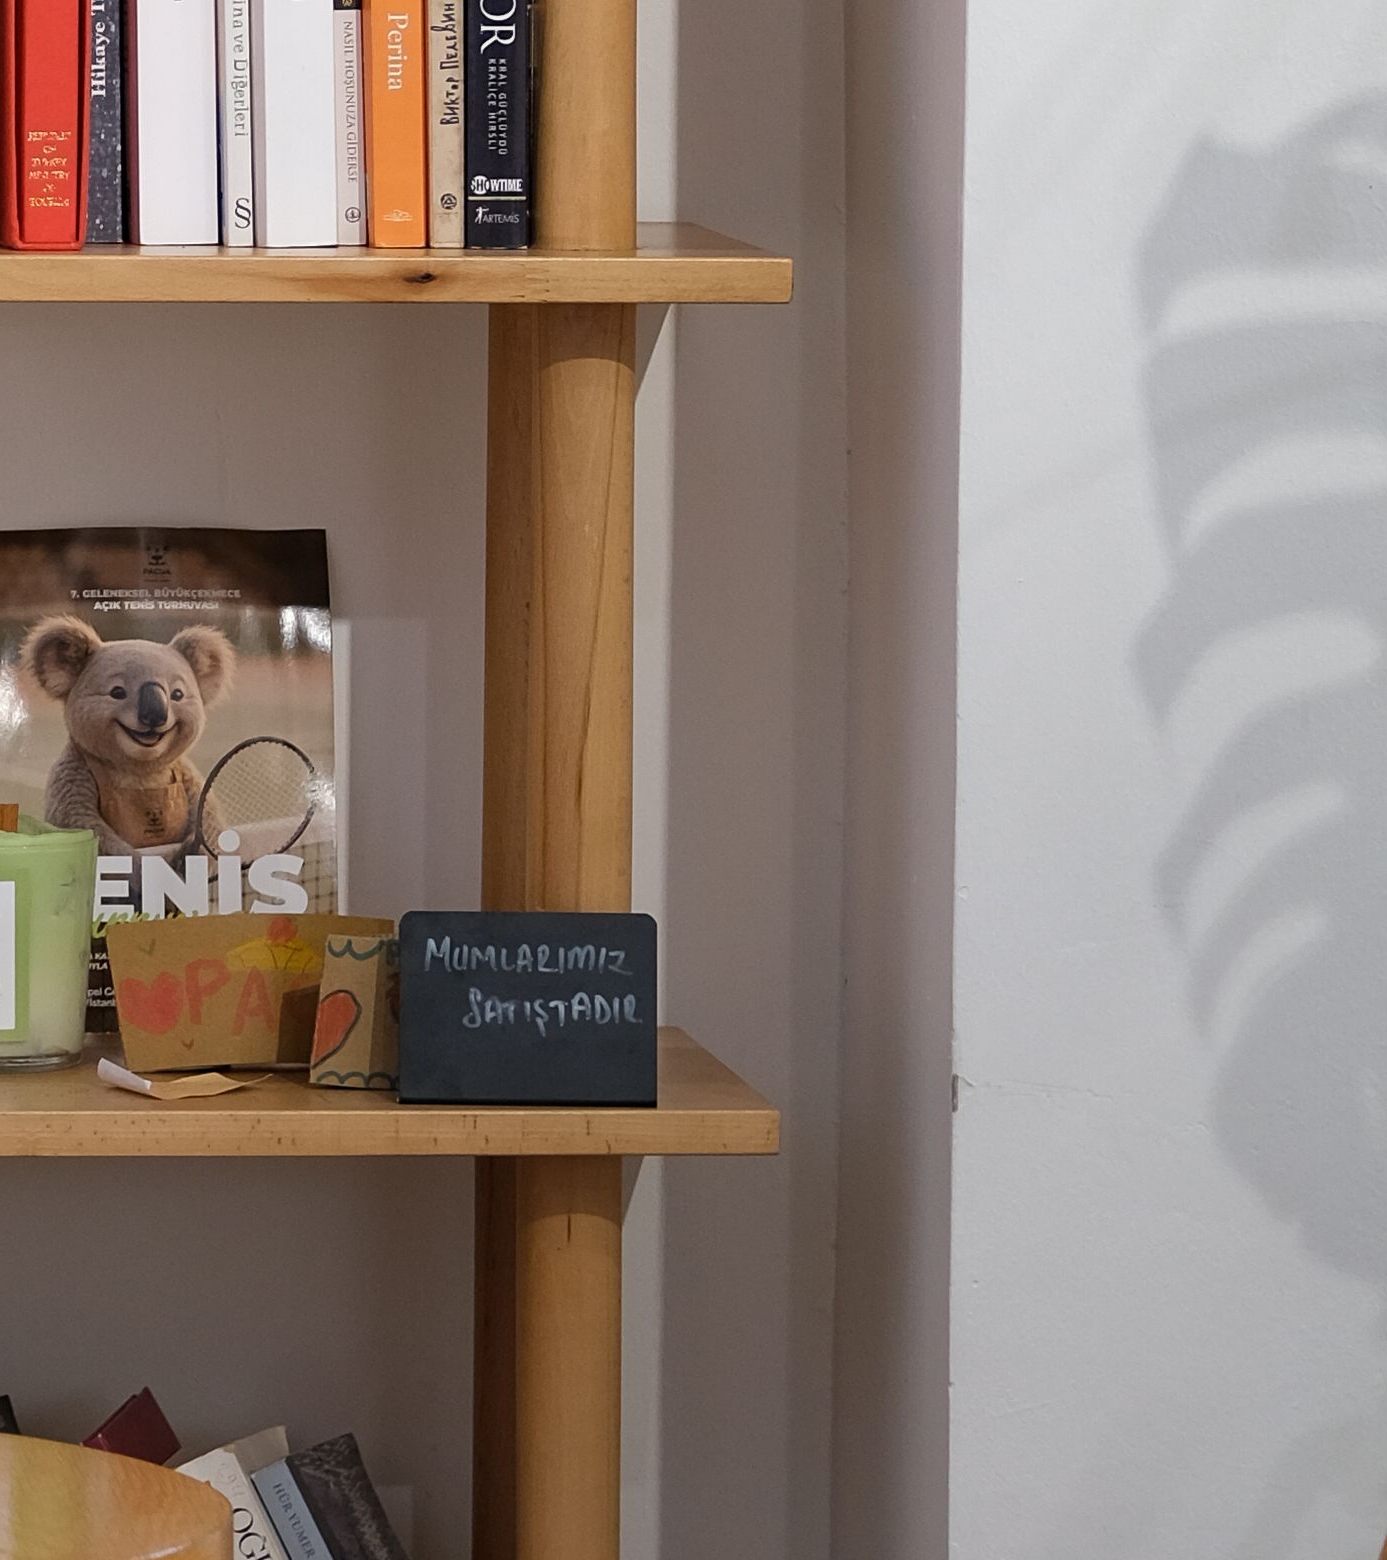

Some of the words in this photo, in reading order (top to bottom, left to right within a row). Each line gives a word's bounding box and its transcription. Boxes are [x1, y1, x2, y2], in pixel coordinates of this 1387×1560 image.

[233, 33, 244, 54] ve
[387, 12, 409, 90] Perina
[233, 57, 250, 138] Diğerleri
[470, 175, 523, 195] SHOWTIME
[70, 589, 80, 599] 7.
[82, 589, 151, 599] GELENEKSEL
[153, 587, 241, 599] BÜYÜKÇEKMECE
[93, 600, 121, 612] AÇIK
[124, 599, 156, 610] TENİS
[424, 935, 633, 976] MUMLARIMIZ
[462, 987, 643, 1038] SATIŞTADIR
